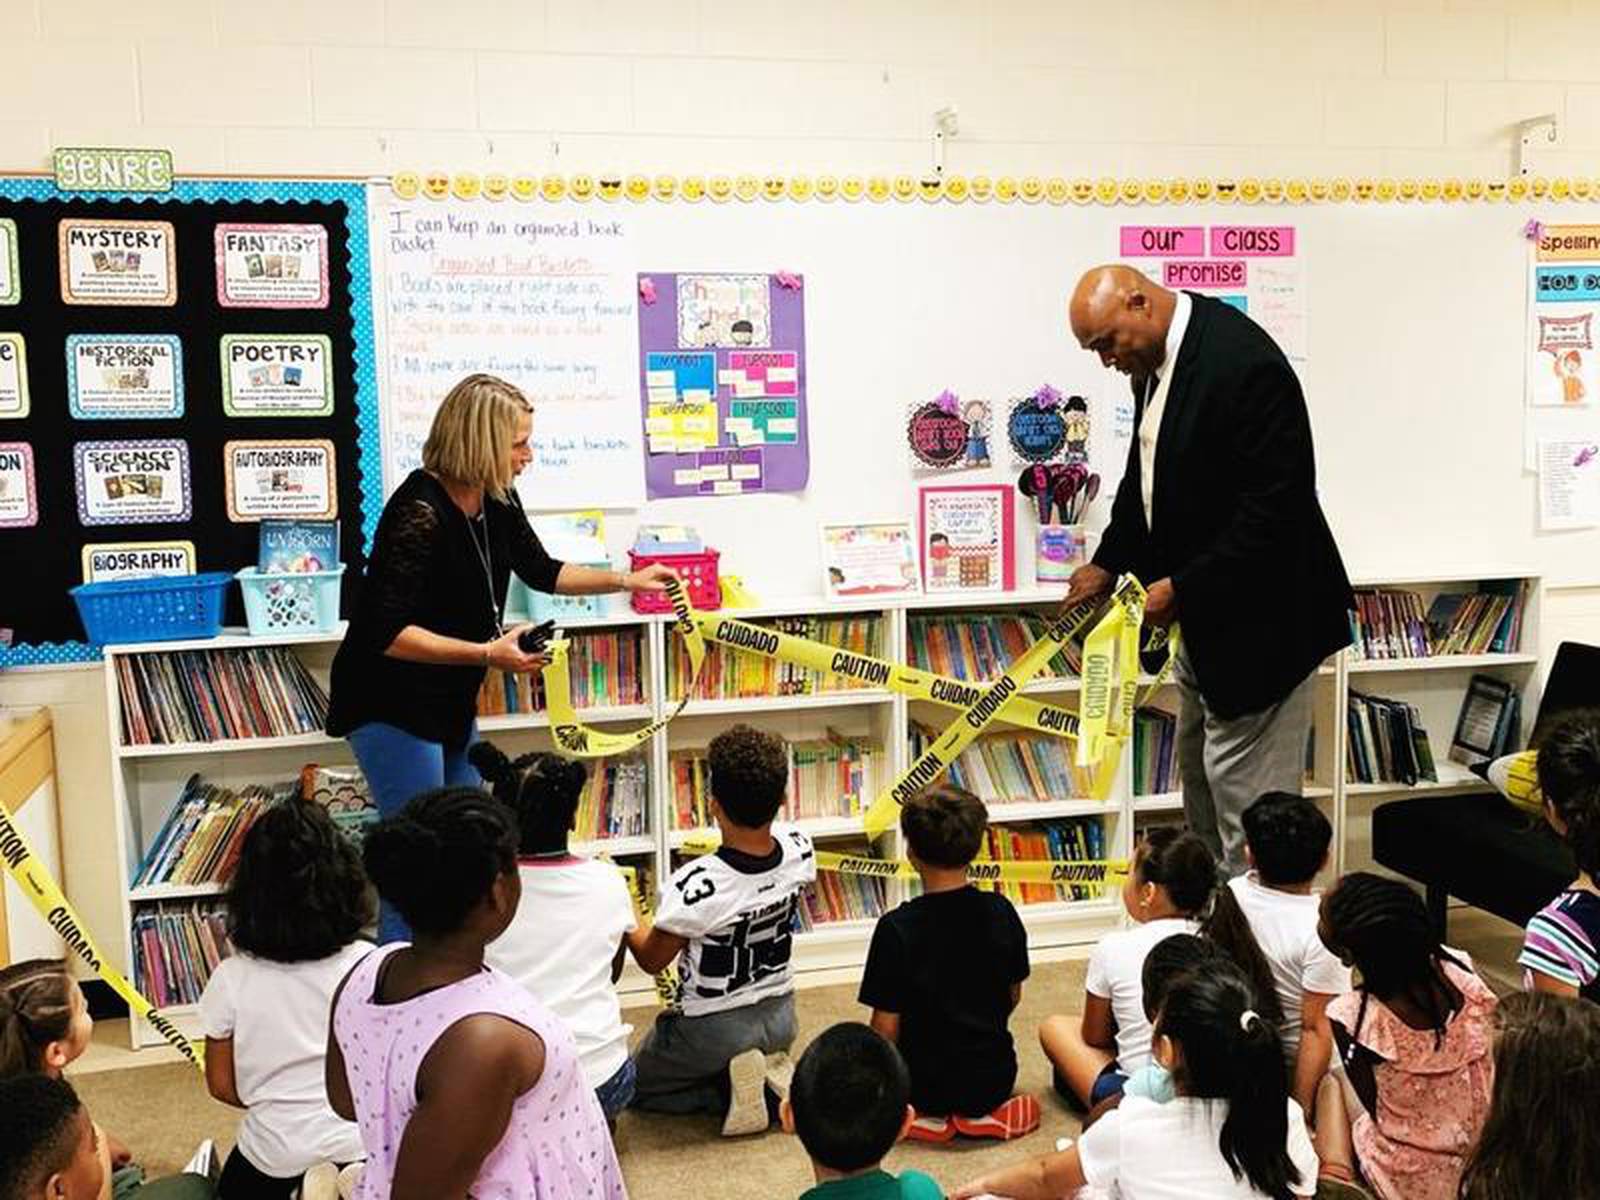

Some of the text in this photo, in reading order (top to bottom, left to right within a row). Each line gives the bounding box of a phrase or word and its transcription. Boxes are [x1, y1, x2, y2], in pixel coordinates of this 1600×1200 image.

[391, 211, 411, 234] I
[415, 217, 443, 233] can
[486, 218, 506, 235] an
[71, 230, 162, 249] MYSTERY
[227, 235, 315, 253] FANTASY
[95, 356, 154, 367] FICTION
[232, 345, 319, 362] POETRY
[94, 554, 183, 571] BIOGRAPHY
[716, 621, 779, 655] CUIDADO
[831, 652, 891, 685] CAUTION
[930, 679, 980, 706] CUIDAD
[965, 675, 1016, 728] CUIDADO
[1037, 707, 1080, 737] CAUTI
[891, 753, 943, 805] CAUTION
[839, 858, 899, 875] CAUTION
[1051, 864, 1105, 882] CAUTION
[675, 865, 716, 906] 13
